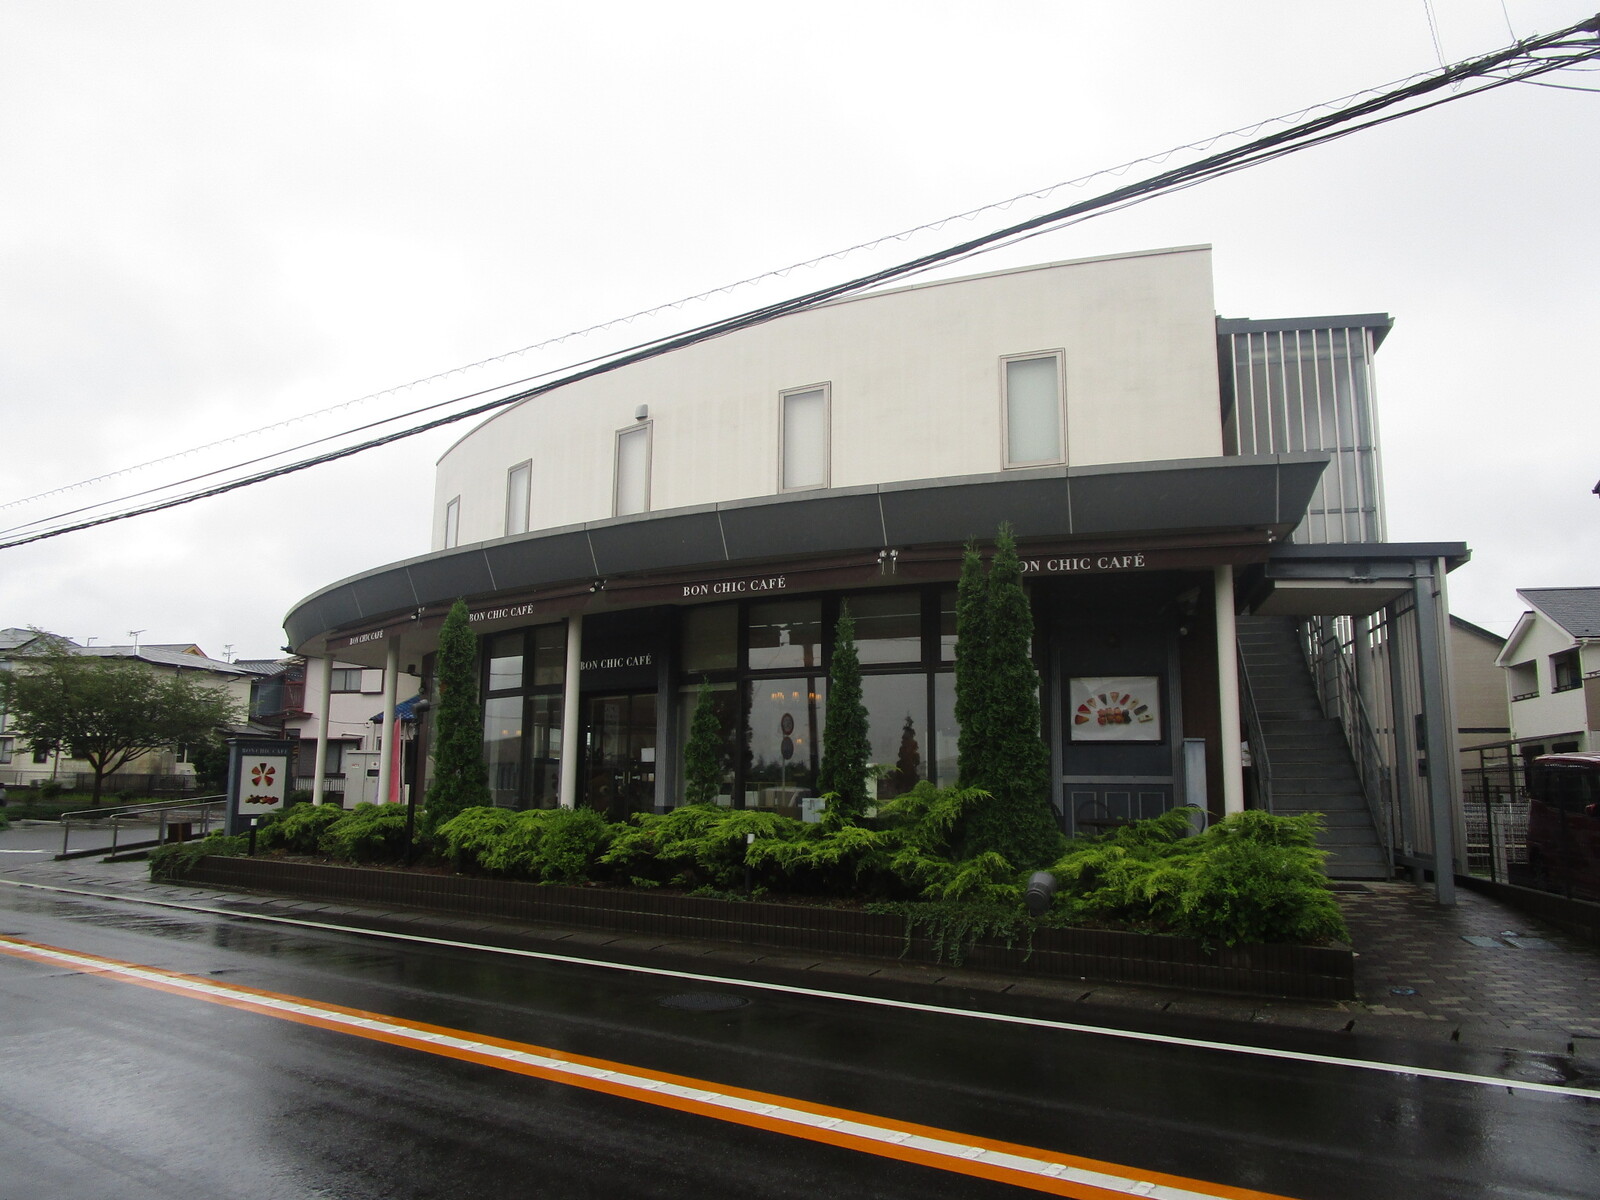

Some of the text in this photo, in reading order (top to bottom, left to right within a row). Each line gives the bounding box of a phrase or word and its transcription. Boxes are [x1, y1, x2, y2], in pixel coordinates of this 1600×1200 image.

[1018, 553, 1146, 573] ON CHIC CAFÉ
[683, 575, 786, 597] BON CHIC CAFÉ
[469, 603, 534, 623] BON CHIC CAFÉ
[580, 653, 652, 671] BON CHIC CAFÉ
